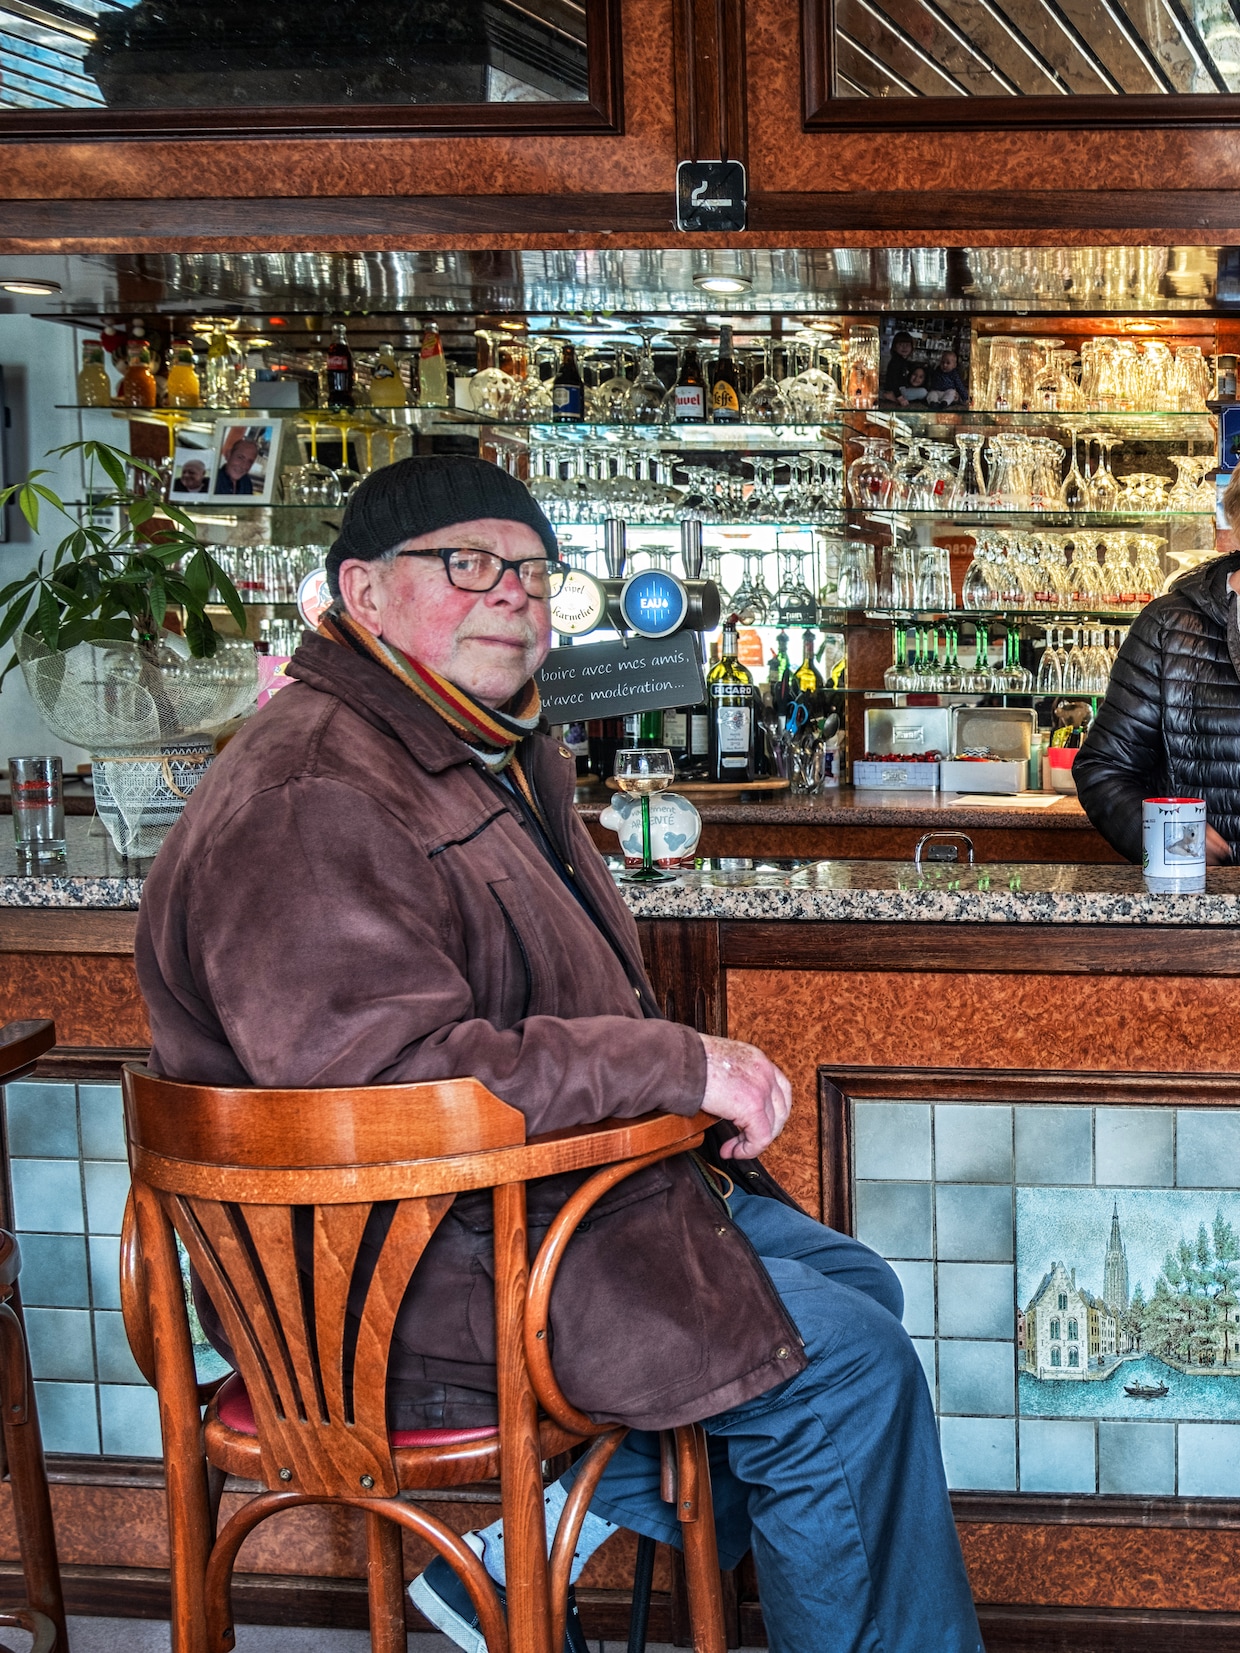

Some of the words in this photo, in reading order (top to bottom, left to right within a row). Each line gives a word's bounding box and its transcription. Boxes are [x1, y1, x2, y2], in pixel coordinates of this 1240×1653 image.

[640, 599, 663, 609] EAU
[541, 667, 577, 682] boire
[581, 663, 612, 676] avec
[618, 657, 647, 671] mes
[651, 650, 690, 666] amis,
[590, 678, 685, 701] modération...
[714, 685, 752, 695] RICARD
[632, 813, 675, 829] ARENTÉ
